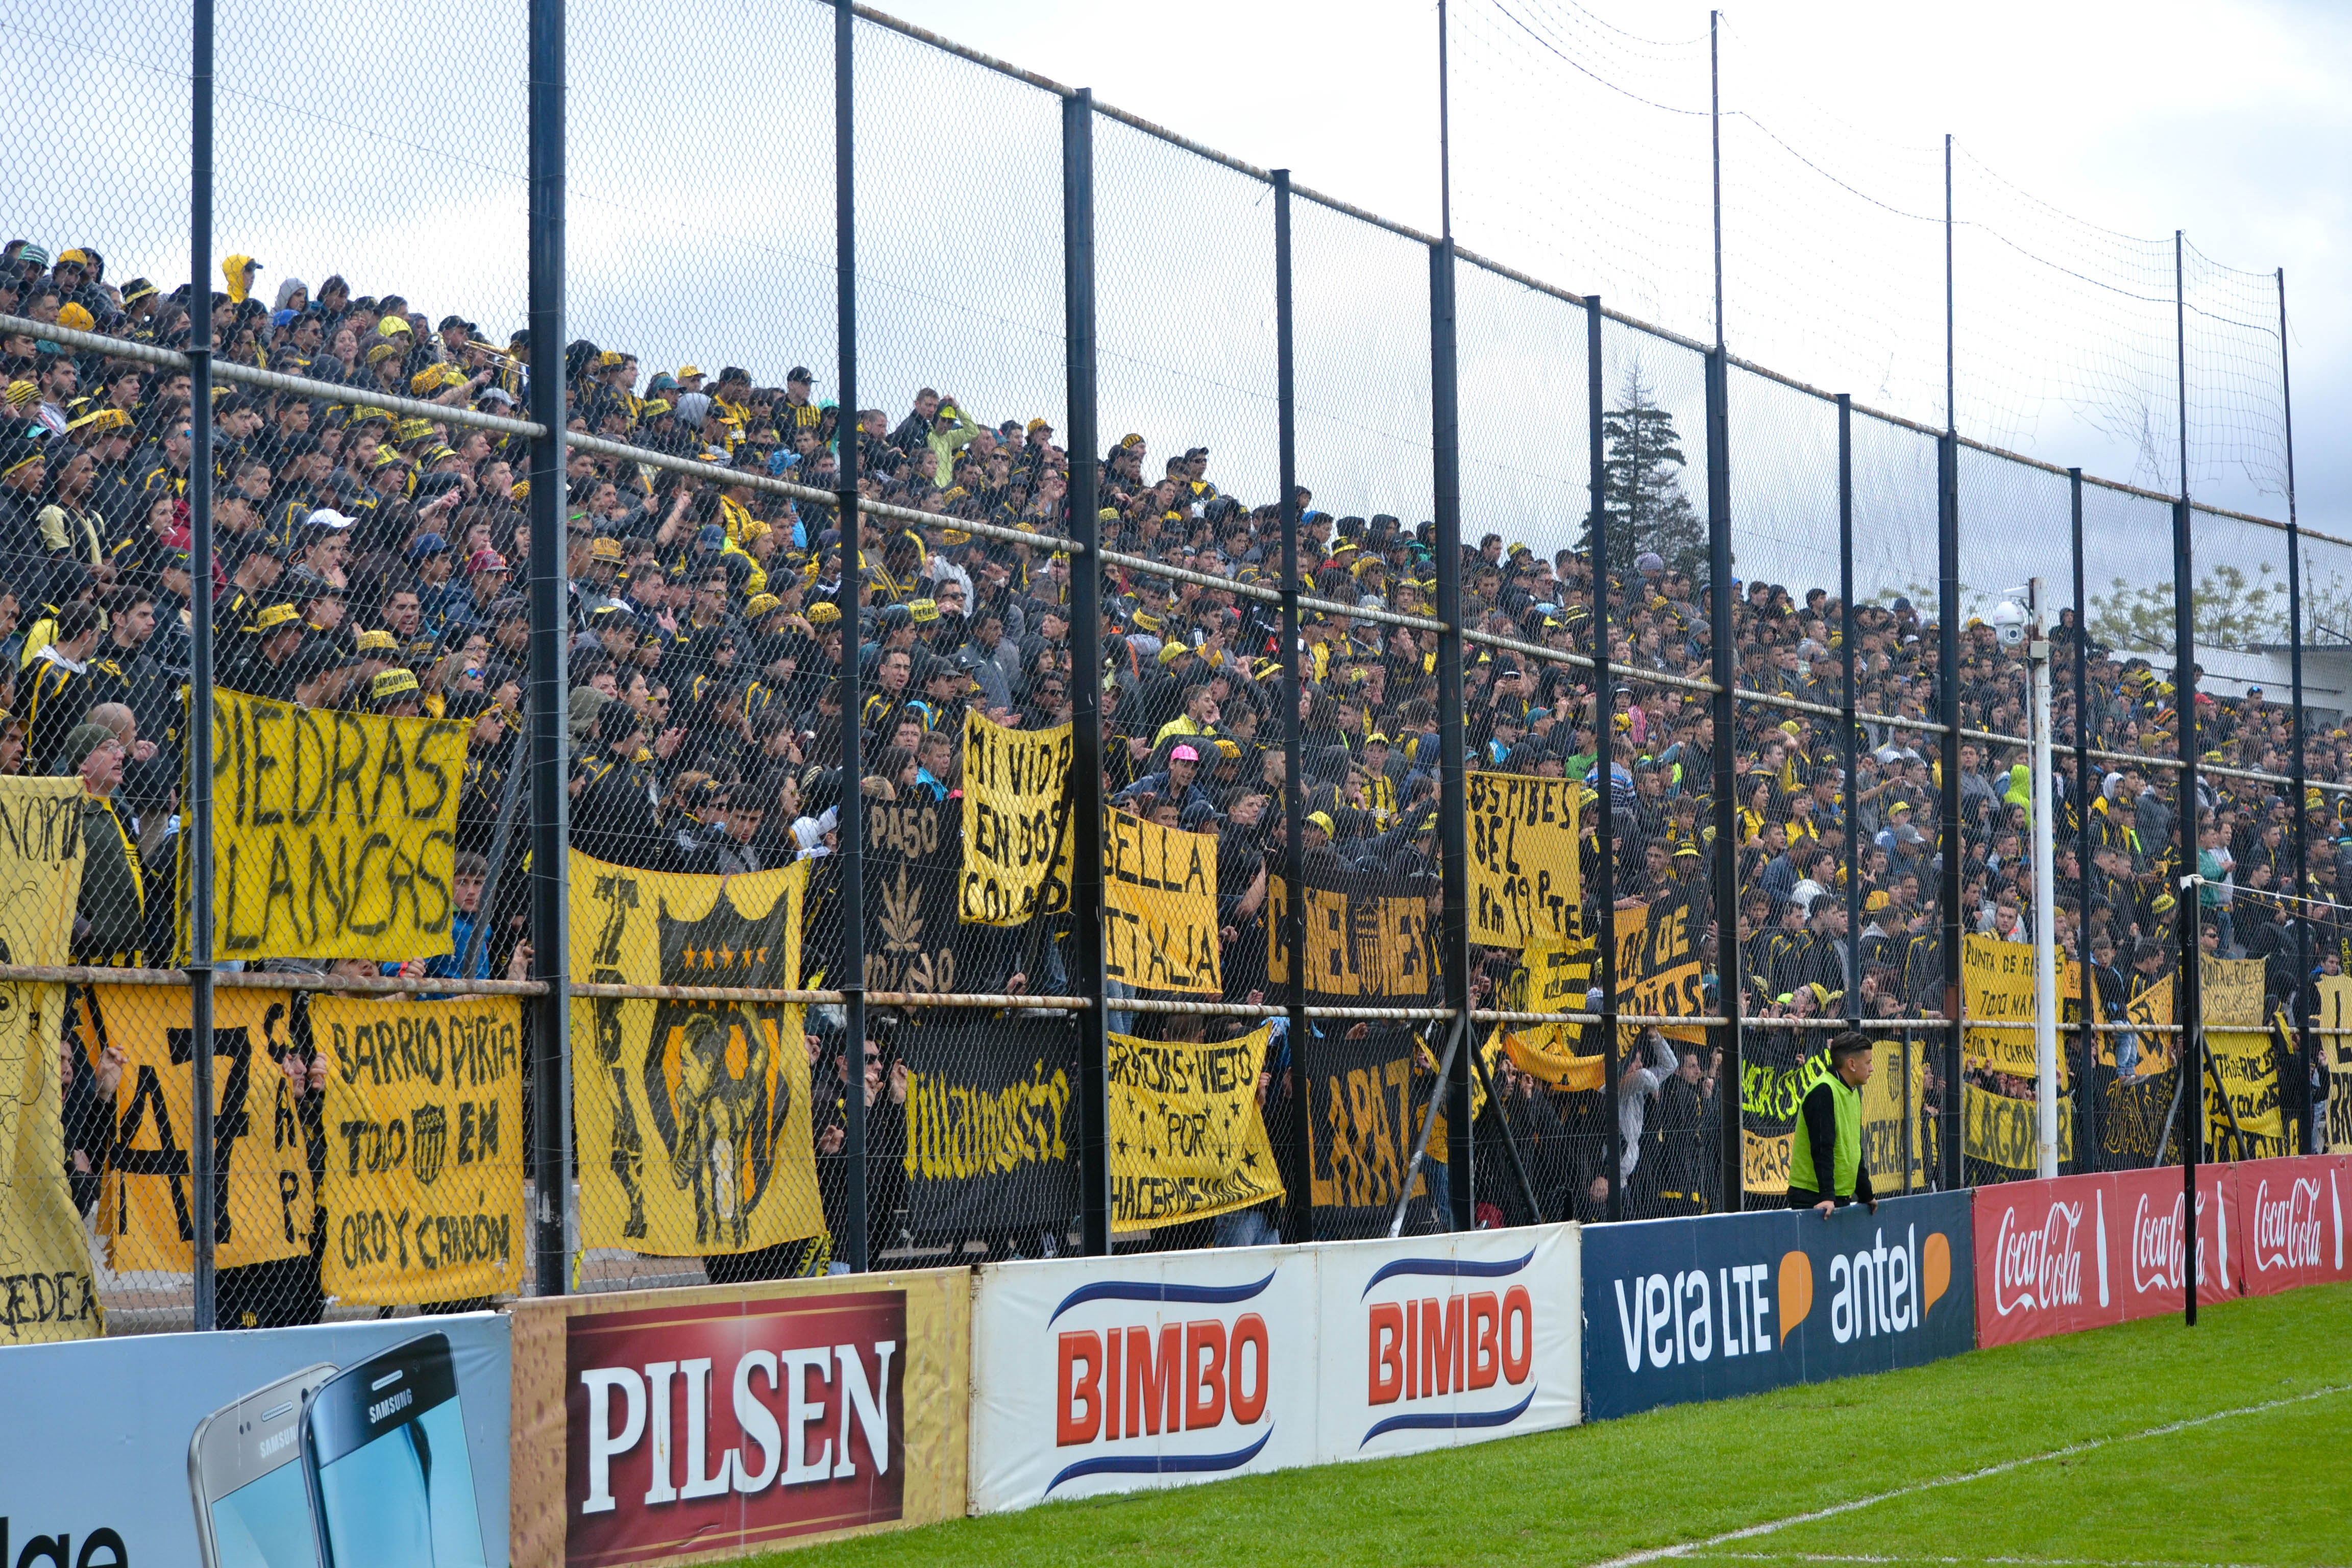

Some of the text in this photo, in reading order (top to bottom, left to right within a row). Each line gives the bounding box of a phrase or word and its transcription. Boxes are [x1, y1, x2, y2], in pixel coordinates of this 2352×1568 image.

[184, 697, 462, 829] PIEDRAS
[1466, 774, 1500, 814] OS
[870, 805, 937, 859] PASO
[976, 801, 1010, 869] EN
[1475, 815, 1520, 875] DEL
[1965, 939, 1995, 973] PUNTA
[2003, 955, 2017, 974] DE
[1980, 990, 2008, 1016] TODO
[332, 1017, 443, 1087] BARRIO
[340, 1100, 499, 1178] TODO EN
[1168, 1113, 1206, 1157] POR
[1965, 1085, 2071, 1169] LAGOR
[341, 1210, 388, 1269] ORO
[389, 1206, 410, 1269] Y
[1995, 1200, 2083, 1316] Coca-Cola
[2133, 1191, 2206, 1293] Coca-Coa
[2253, 1177, 2321, 1271] Coca-Cola
[1614, 1263, 1771, 1373] vera LTE
[1829, 1222, 1918, 1343] antel
[1057, 1312, 1269, 1447] BIMBO
[1368, 1284, 1532, 1406] BIMBO
[260, 1424, 300, 1458] SAMSUN
[369, 1388, 413, 1424] SAMSUNG
[581, 1340, 895, 1514] PILSEN
